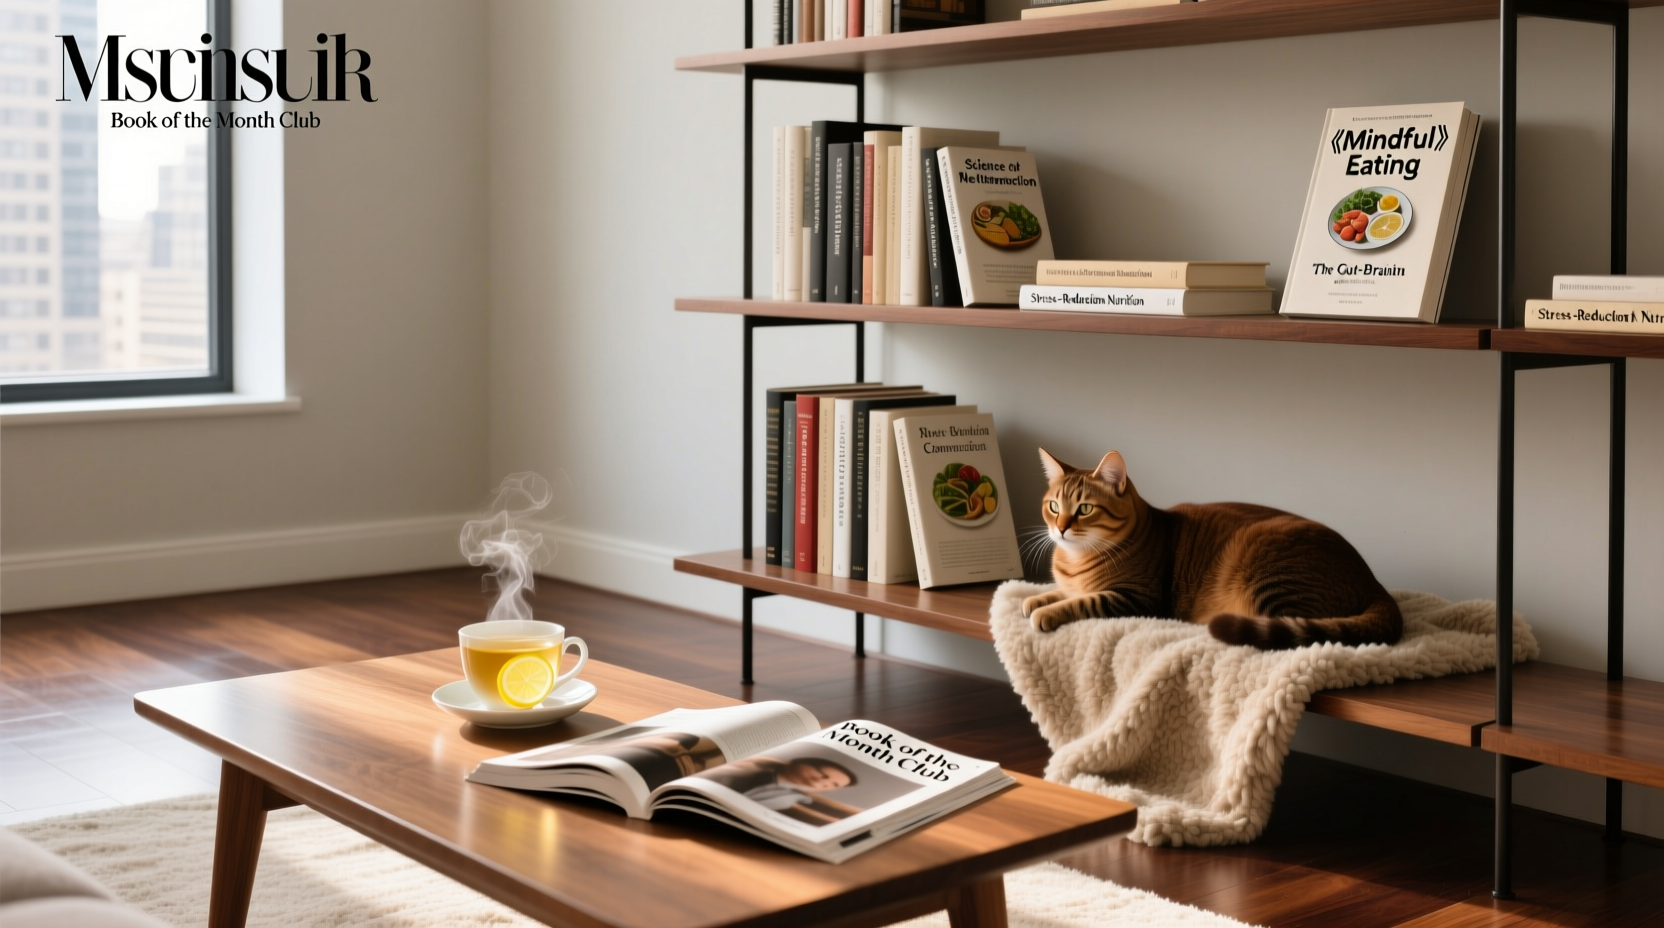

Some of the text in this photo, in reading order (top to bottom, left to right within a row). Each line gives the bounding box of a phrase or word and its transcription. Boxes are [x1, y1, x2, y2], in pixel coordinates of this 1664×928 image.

[1345, 154, 1421, 180] Eating
[1313, 263, 1333, 275] The
[841, 722, 896, 749] Book
[899, 745, 927, 757] of
[822, 730, 894, 764] Month
[897, 758, 950, 781] Club
